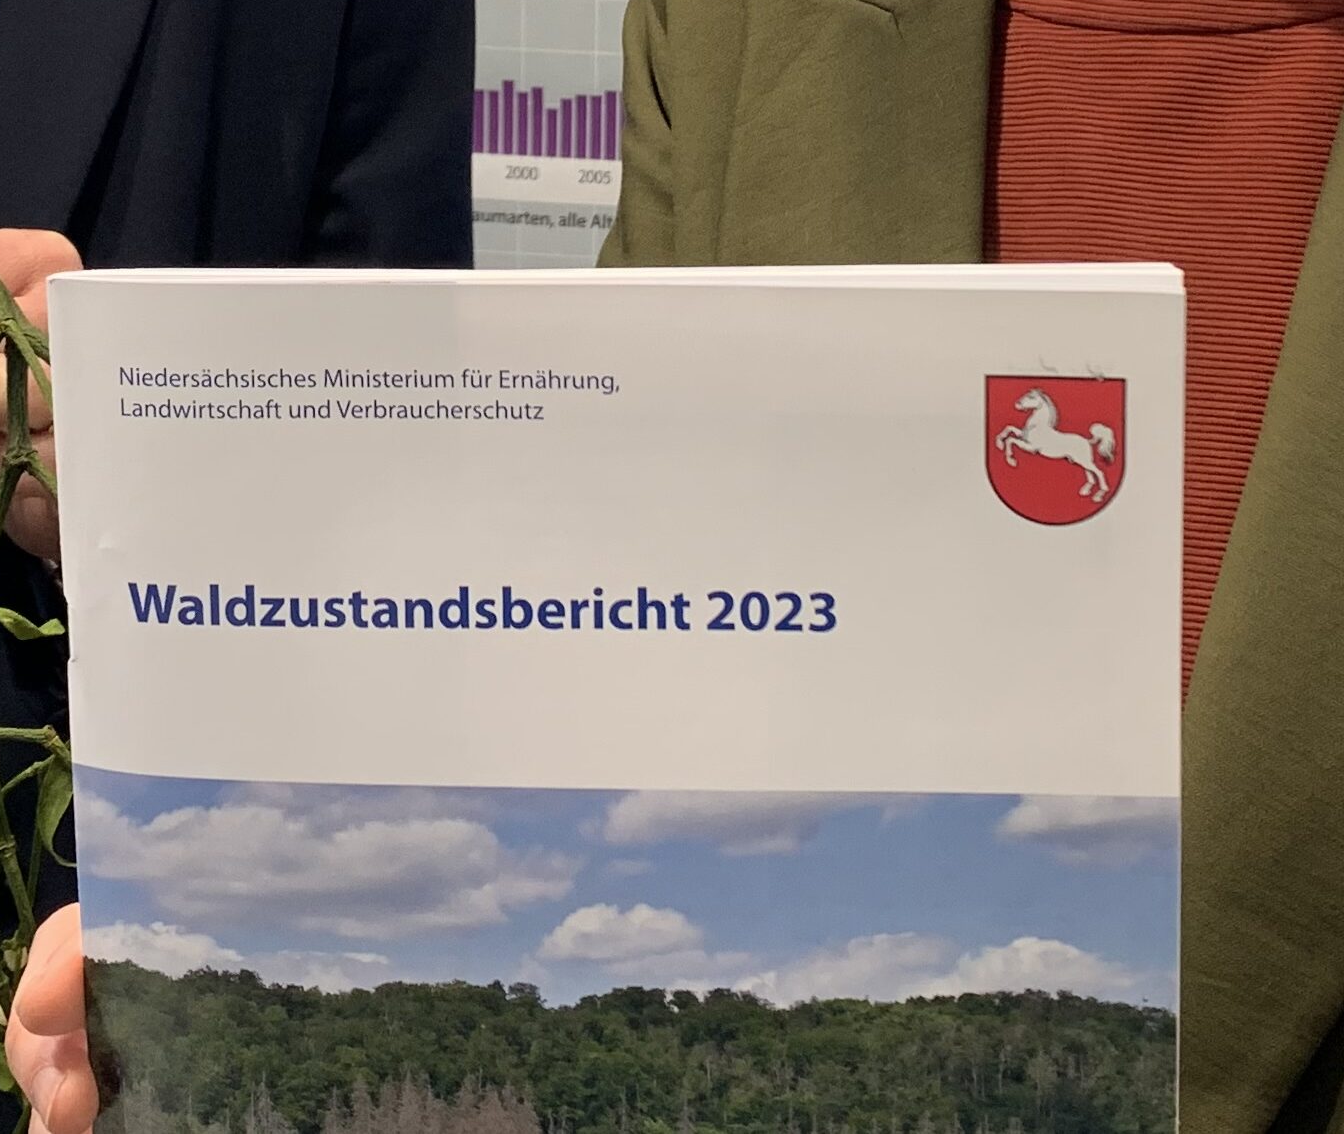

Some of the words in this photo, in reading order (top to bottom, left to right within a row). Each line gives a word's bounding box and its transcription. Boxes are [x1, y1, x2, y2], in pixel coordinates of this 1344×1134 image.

[505, 165, 539, 181] 2000
[578, 169, 612, 185] 2005
[472, 211, 554, 229] aumarten,
[557, 211, 586, 229] alle
[119, 366, 318, 389] Niedersächsisches
[324, 368, 455, 389] Ministerium
[461, 369, 490, 389] für
[499, 369, 621, 395] Ernährung,
[121, 398, 283, 420] Landwirtschaft
[289, 399, 331, 420] und
[337, 399, 545, 421] Verbraucherschutz
[128, 581, 691, 632] Waldzustandsbericht
[706, 590, 838, 634] 2023
